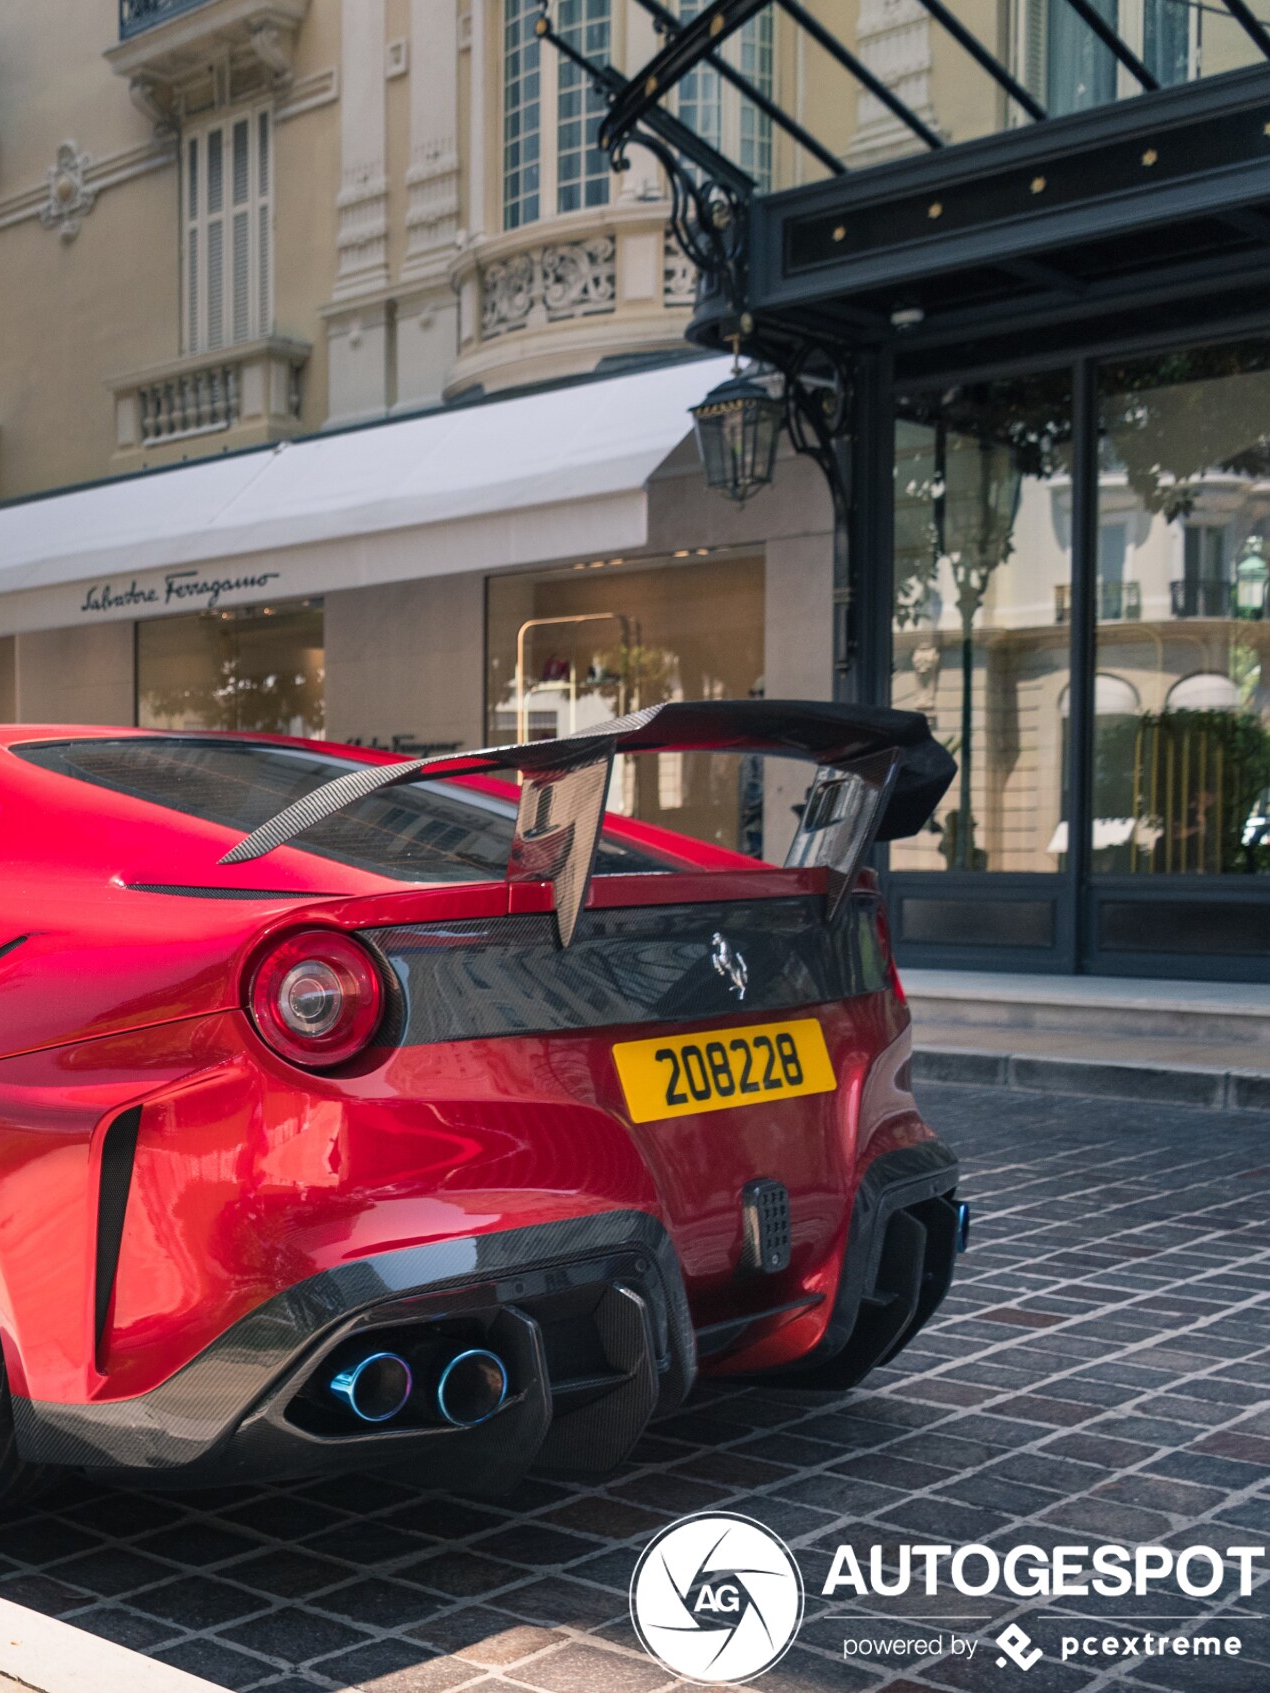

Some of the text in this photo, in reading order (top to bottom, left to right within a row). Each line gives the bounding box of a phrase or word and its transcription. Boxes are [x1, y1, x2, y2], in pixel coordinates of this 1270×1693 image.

[81, 570, 280, 612] Salvatore Ferragamo
[655, 1033, 804, 1106] 208228
